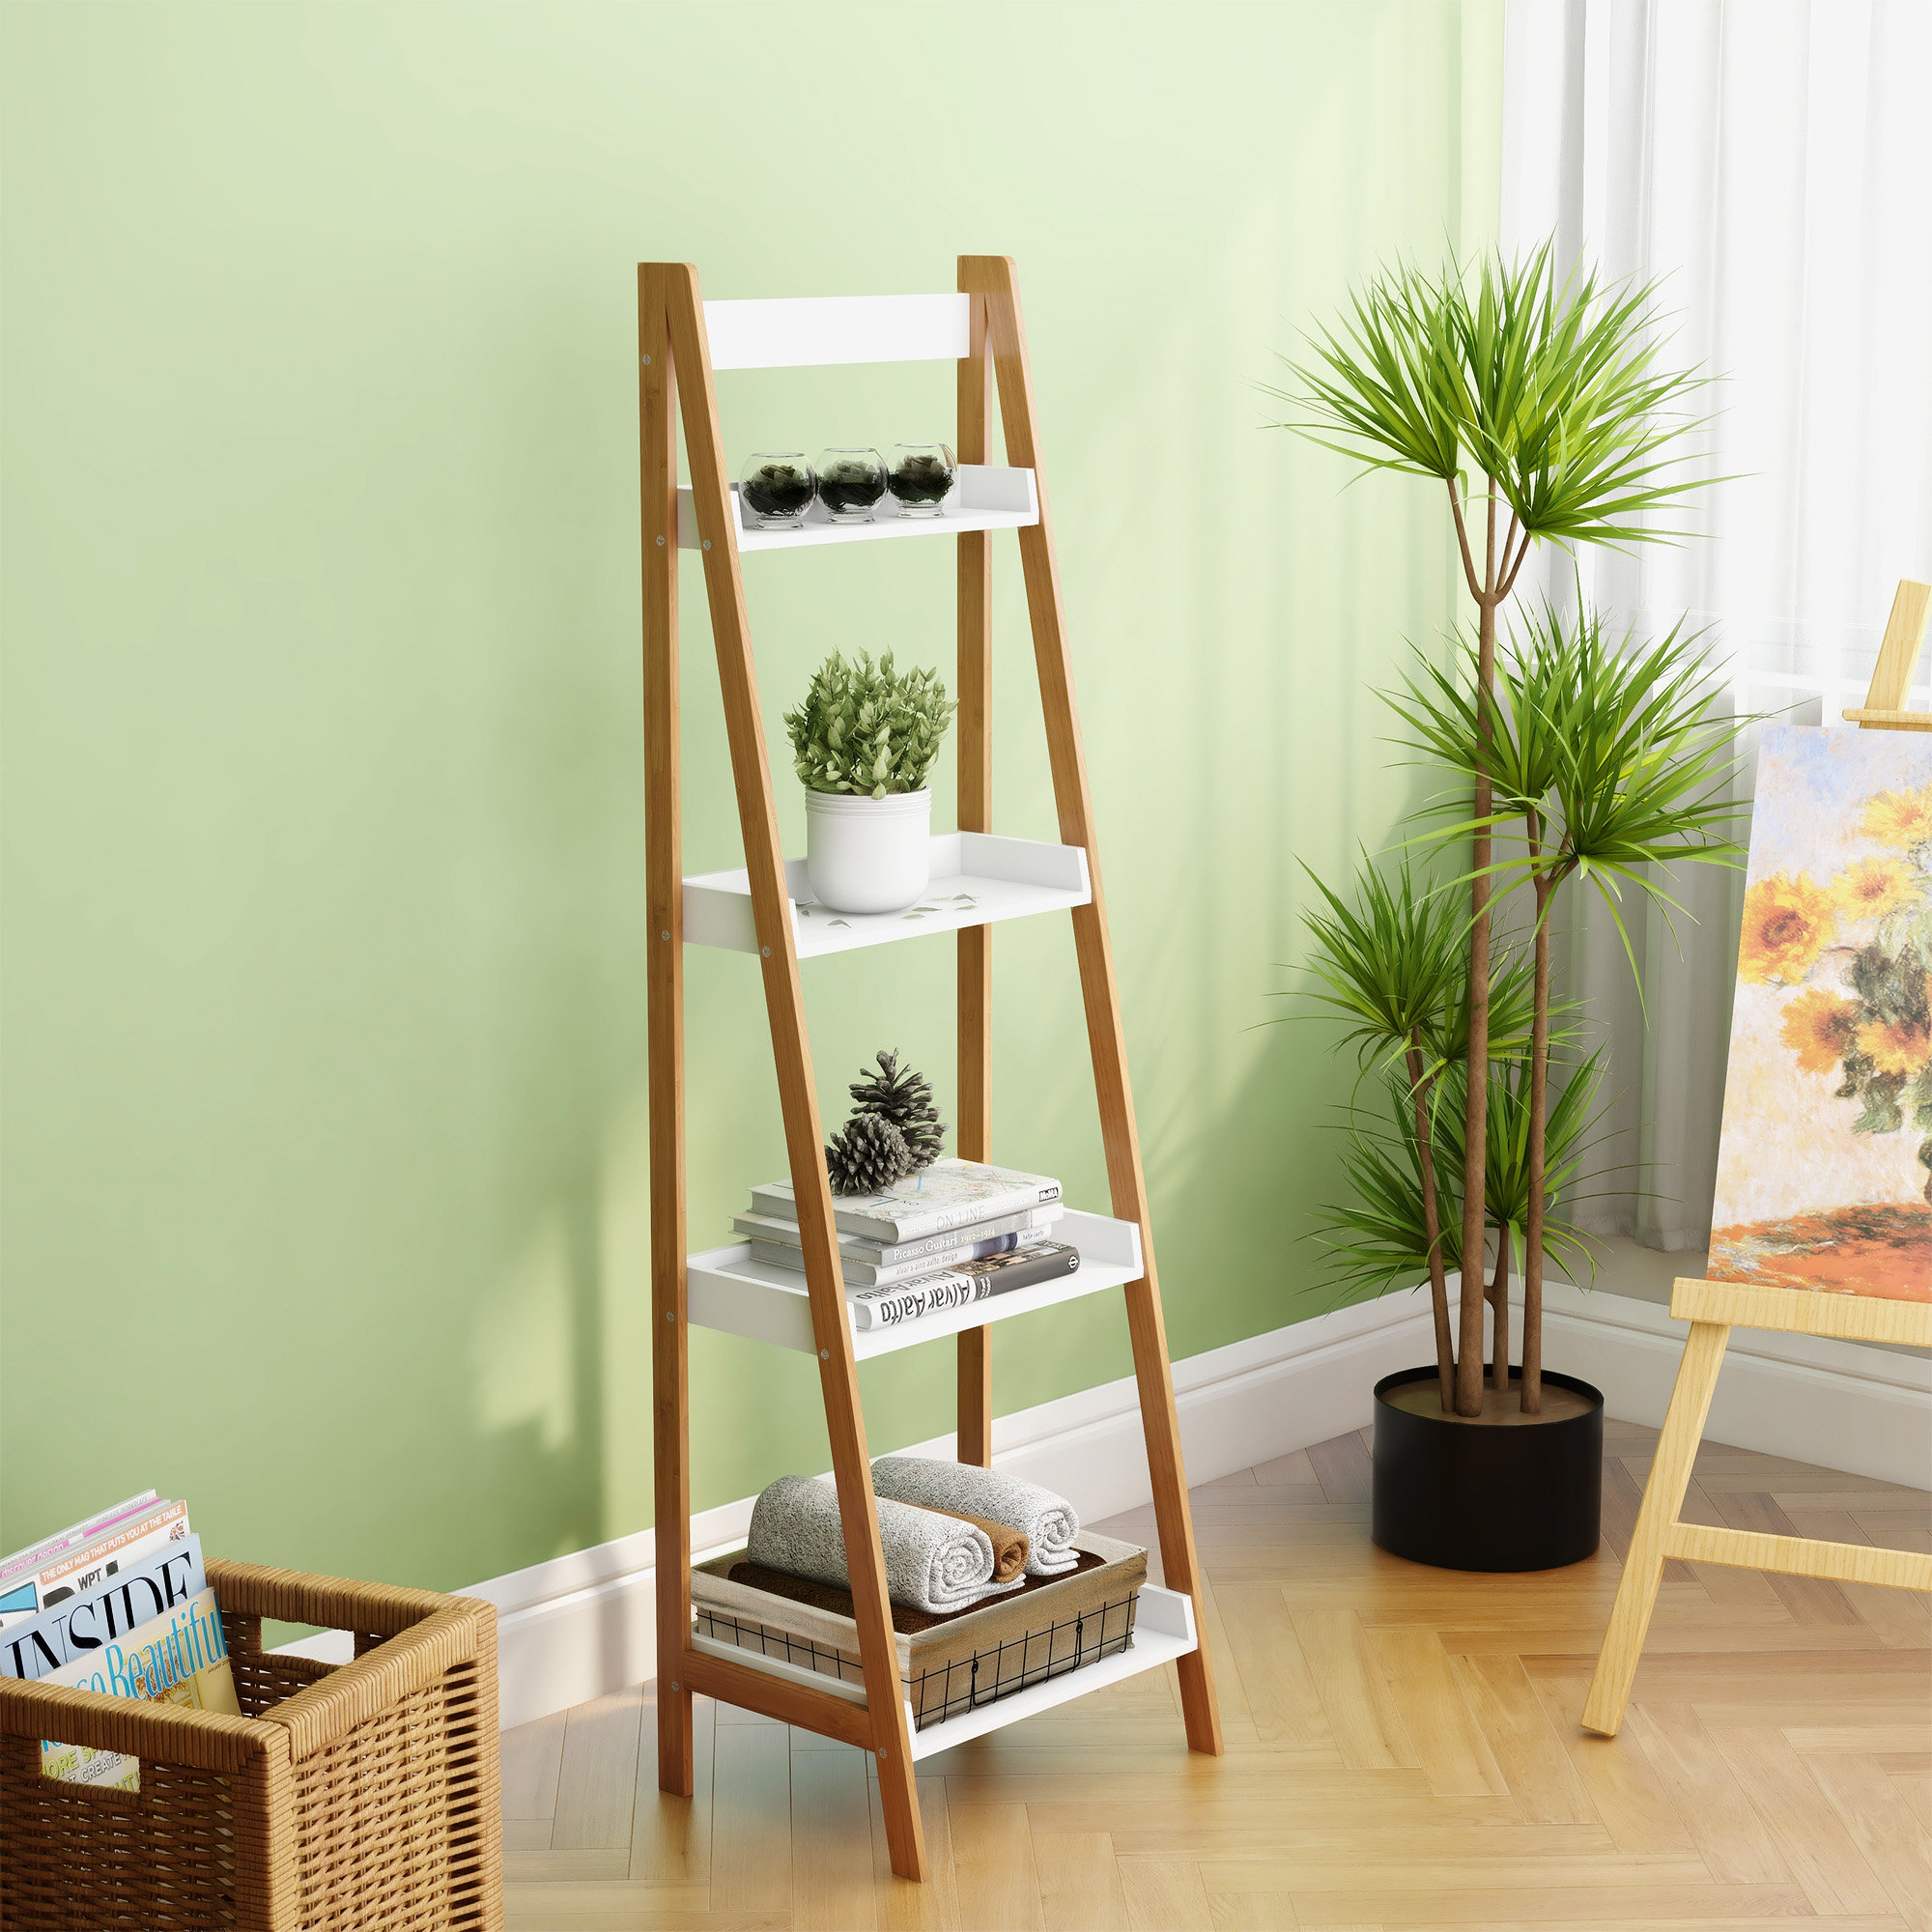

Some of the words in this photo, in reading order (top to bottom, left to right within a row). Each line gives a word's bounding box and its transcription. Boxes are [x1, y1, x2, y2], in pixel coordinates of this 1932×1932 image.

[1039, 1187, 1059, 1202] MoMA
[937, 1212, 956, 1231] ON
[959, 1205, 985, 1225] LINE
[893, 1246, 924, 1261] Picasso
[925, 1236, 958, 1252] Guitars
[880, 1293, 925, 1325] Aalto
[927, 1280, 970, 1310] Alvar
[42, 1568, 56, 1582] THE
[56, 1559, 73, 1577] ONLY
[74, 1551, 90, 1567] MAG
[90, 1544, 108, 1560] THAT
[107, 1535, 127, 1553] PUTS
[125, 1527, 140, 1544] YOU
[139, 1521, 150, 1536] AT
[149, 1517, 163, 1531] THE
[161, 1505, 182, 1523] TABLE
[77, 1567, 101, 1591] WPT
[104, 1591, 228, 1700] Beautiful
[81, 1752, 121, 1781] CREATE
